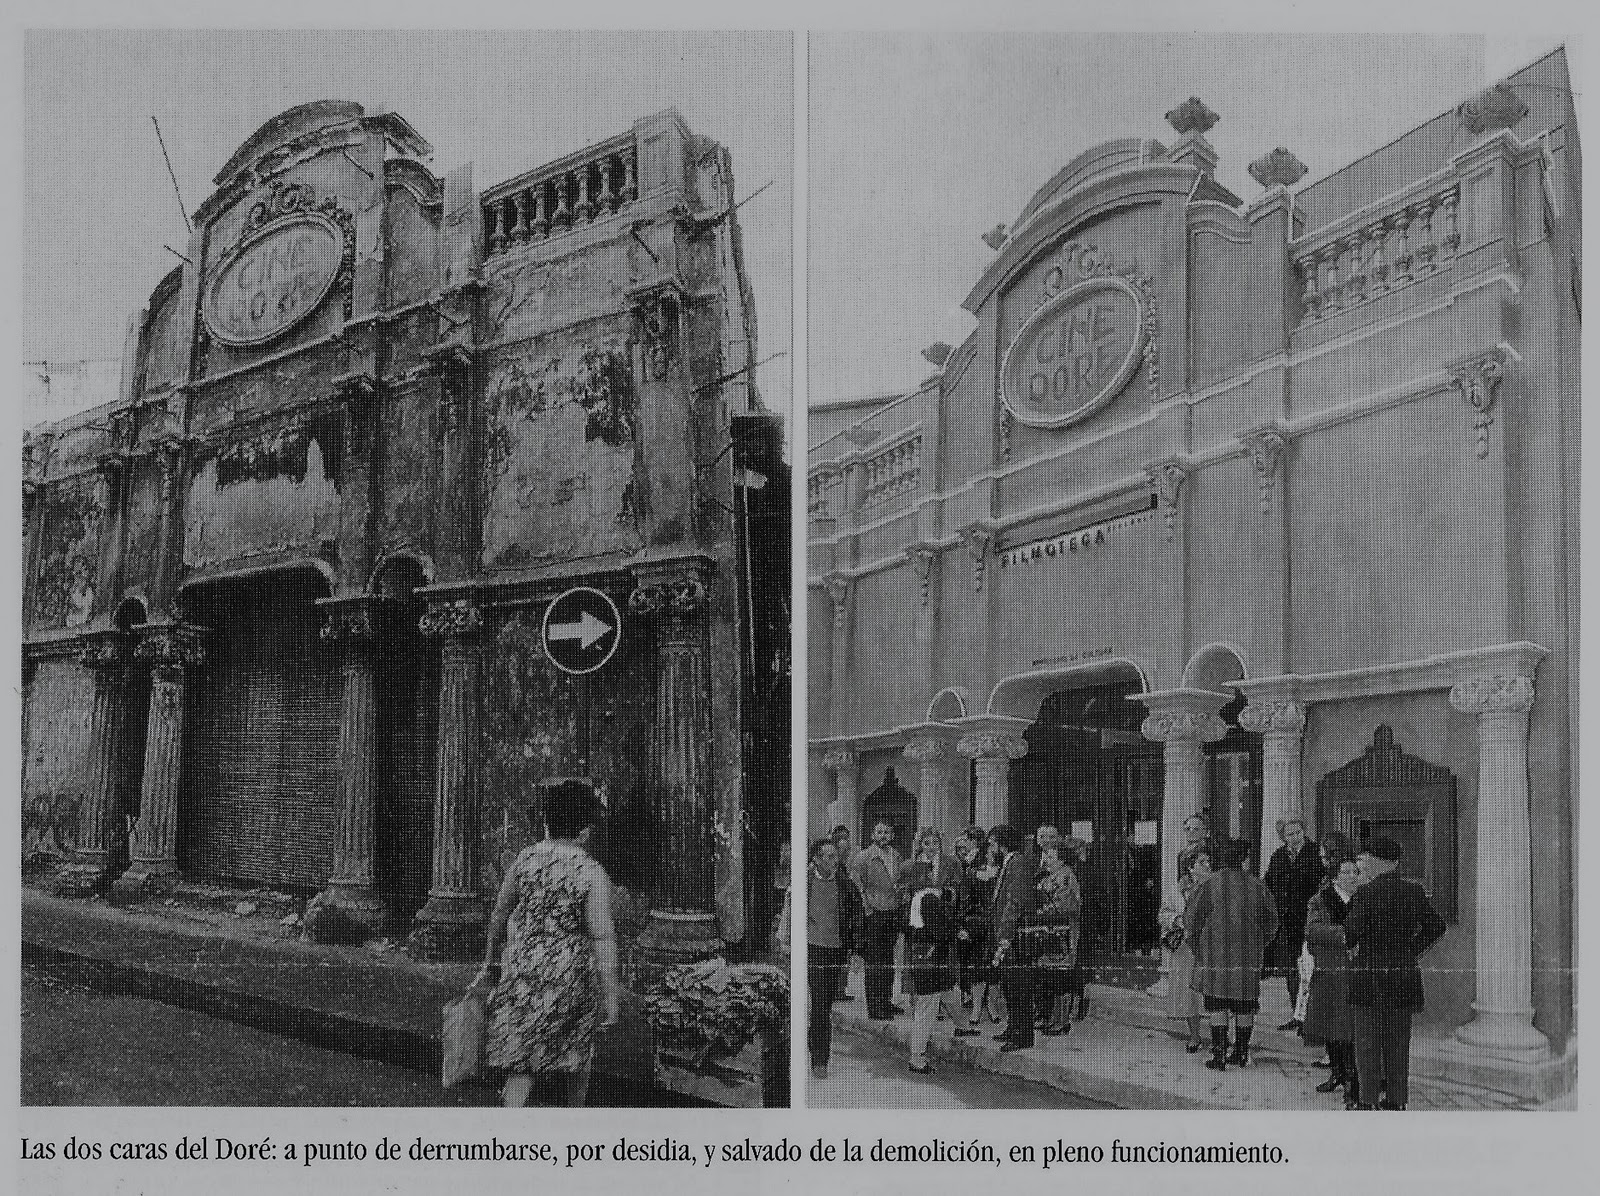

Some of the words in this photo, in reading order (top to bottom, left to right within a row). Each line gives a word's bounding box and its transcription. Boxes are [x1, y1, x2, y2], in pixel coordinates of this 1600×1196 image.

[236, 235, 313, 290] CINE
[1035, 304, 1116, 364] CINE
[1000, 529, 1106, 569] FILMOTECA
[20, 1137, 56, 1160] Las
[63, 1135, 102, 1160] dos
[109, 1142, 168, 1160] caras
[175, 1135, 209, 1160] del
[215, 1136, 277, 1160] Doré:
[284, 1143, 298, 1160] a
[303, 1140, 367, 1167] punto
[375, 1136, 402, 1161] de
[408, 1136, 558, 1166] derrumbarse,
[565, 1144, 606, 1168] por
[612, 1137, 697, 1166] desidia,
[704, 1144, 716, 1168] y
[721, 1137, 802, 1162] salvado
[809, 1138, 836, 1162] de
[842, 1137, 864, 1162] la
[870, 1138, 1001, 1168] demolición,
[1009, 1145, 1036, 1163] en
[1042, 1138, 1104, 1170] pleno
[1110, 1138, 1289, 1164] funcionamiento.
